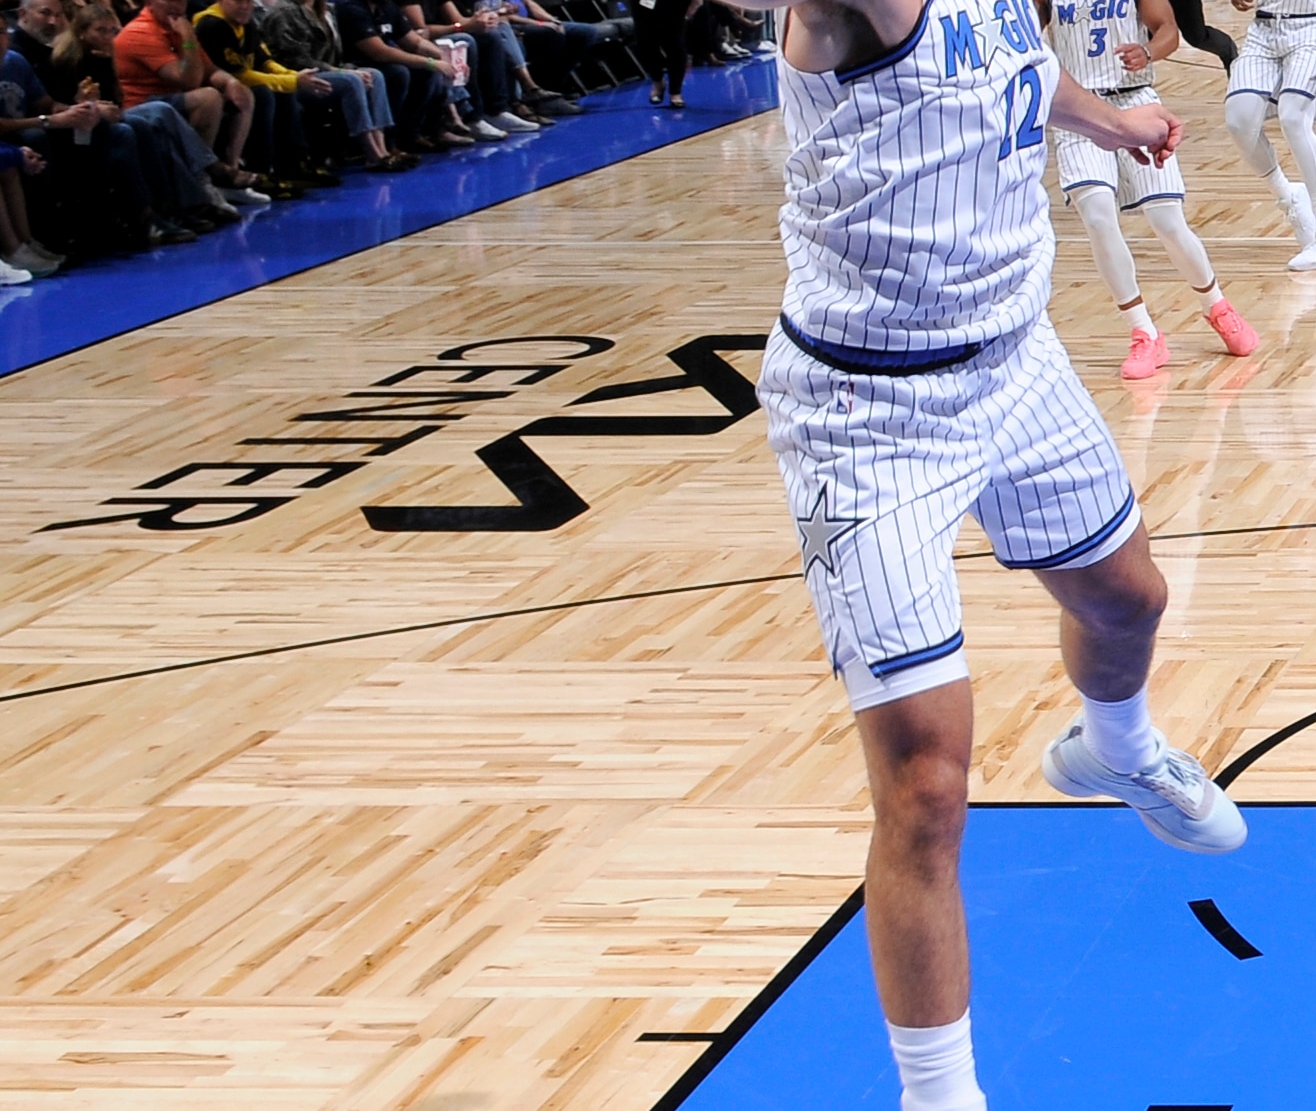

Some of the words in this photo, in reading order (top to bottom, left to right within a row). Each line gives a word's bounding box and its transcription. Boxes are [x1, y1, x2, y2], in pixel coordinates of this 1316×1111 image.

[1087, 27, 1108, 58] 3
[997, 64, 1044, 162] 12
[31, 335, 617, 533] CENTER
